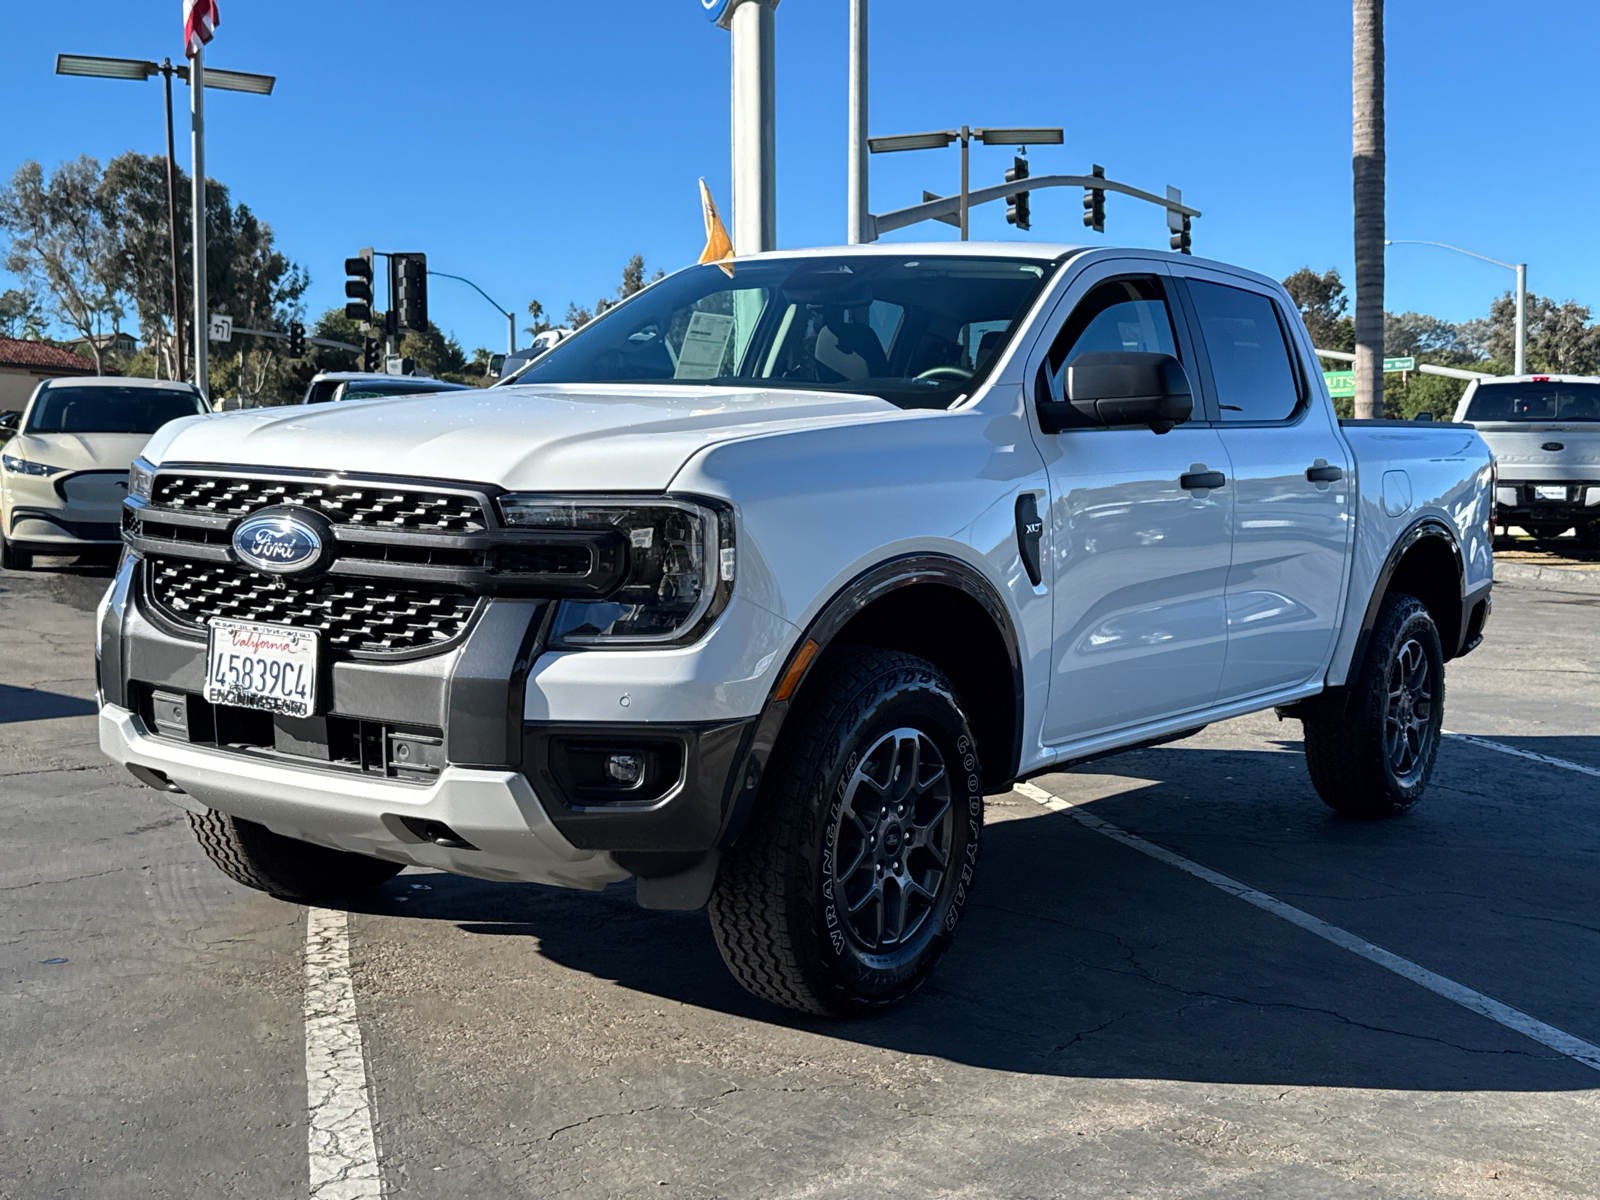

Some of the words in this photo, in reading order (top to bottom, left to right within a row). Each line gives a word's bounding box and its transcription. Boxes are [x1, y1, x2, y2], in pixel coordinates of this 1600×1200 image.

[250, 528, 298, 559] Ford
[1025, 522, 1042, 535] XLT
[232, 630, 298, 655] California
[214, 652, 306, 700] 45839C4
[944, 733, 981, 932] GOODYEAR
[822, 750, 858, 956] WRANGLER
